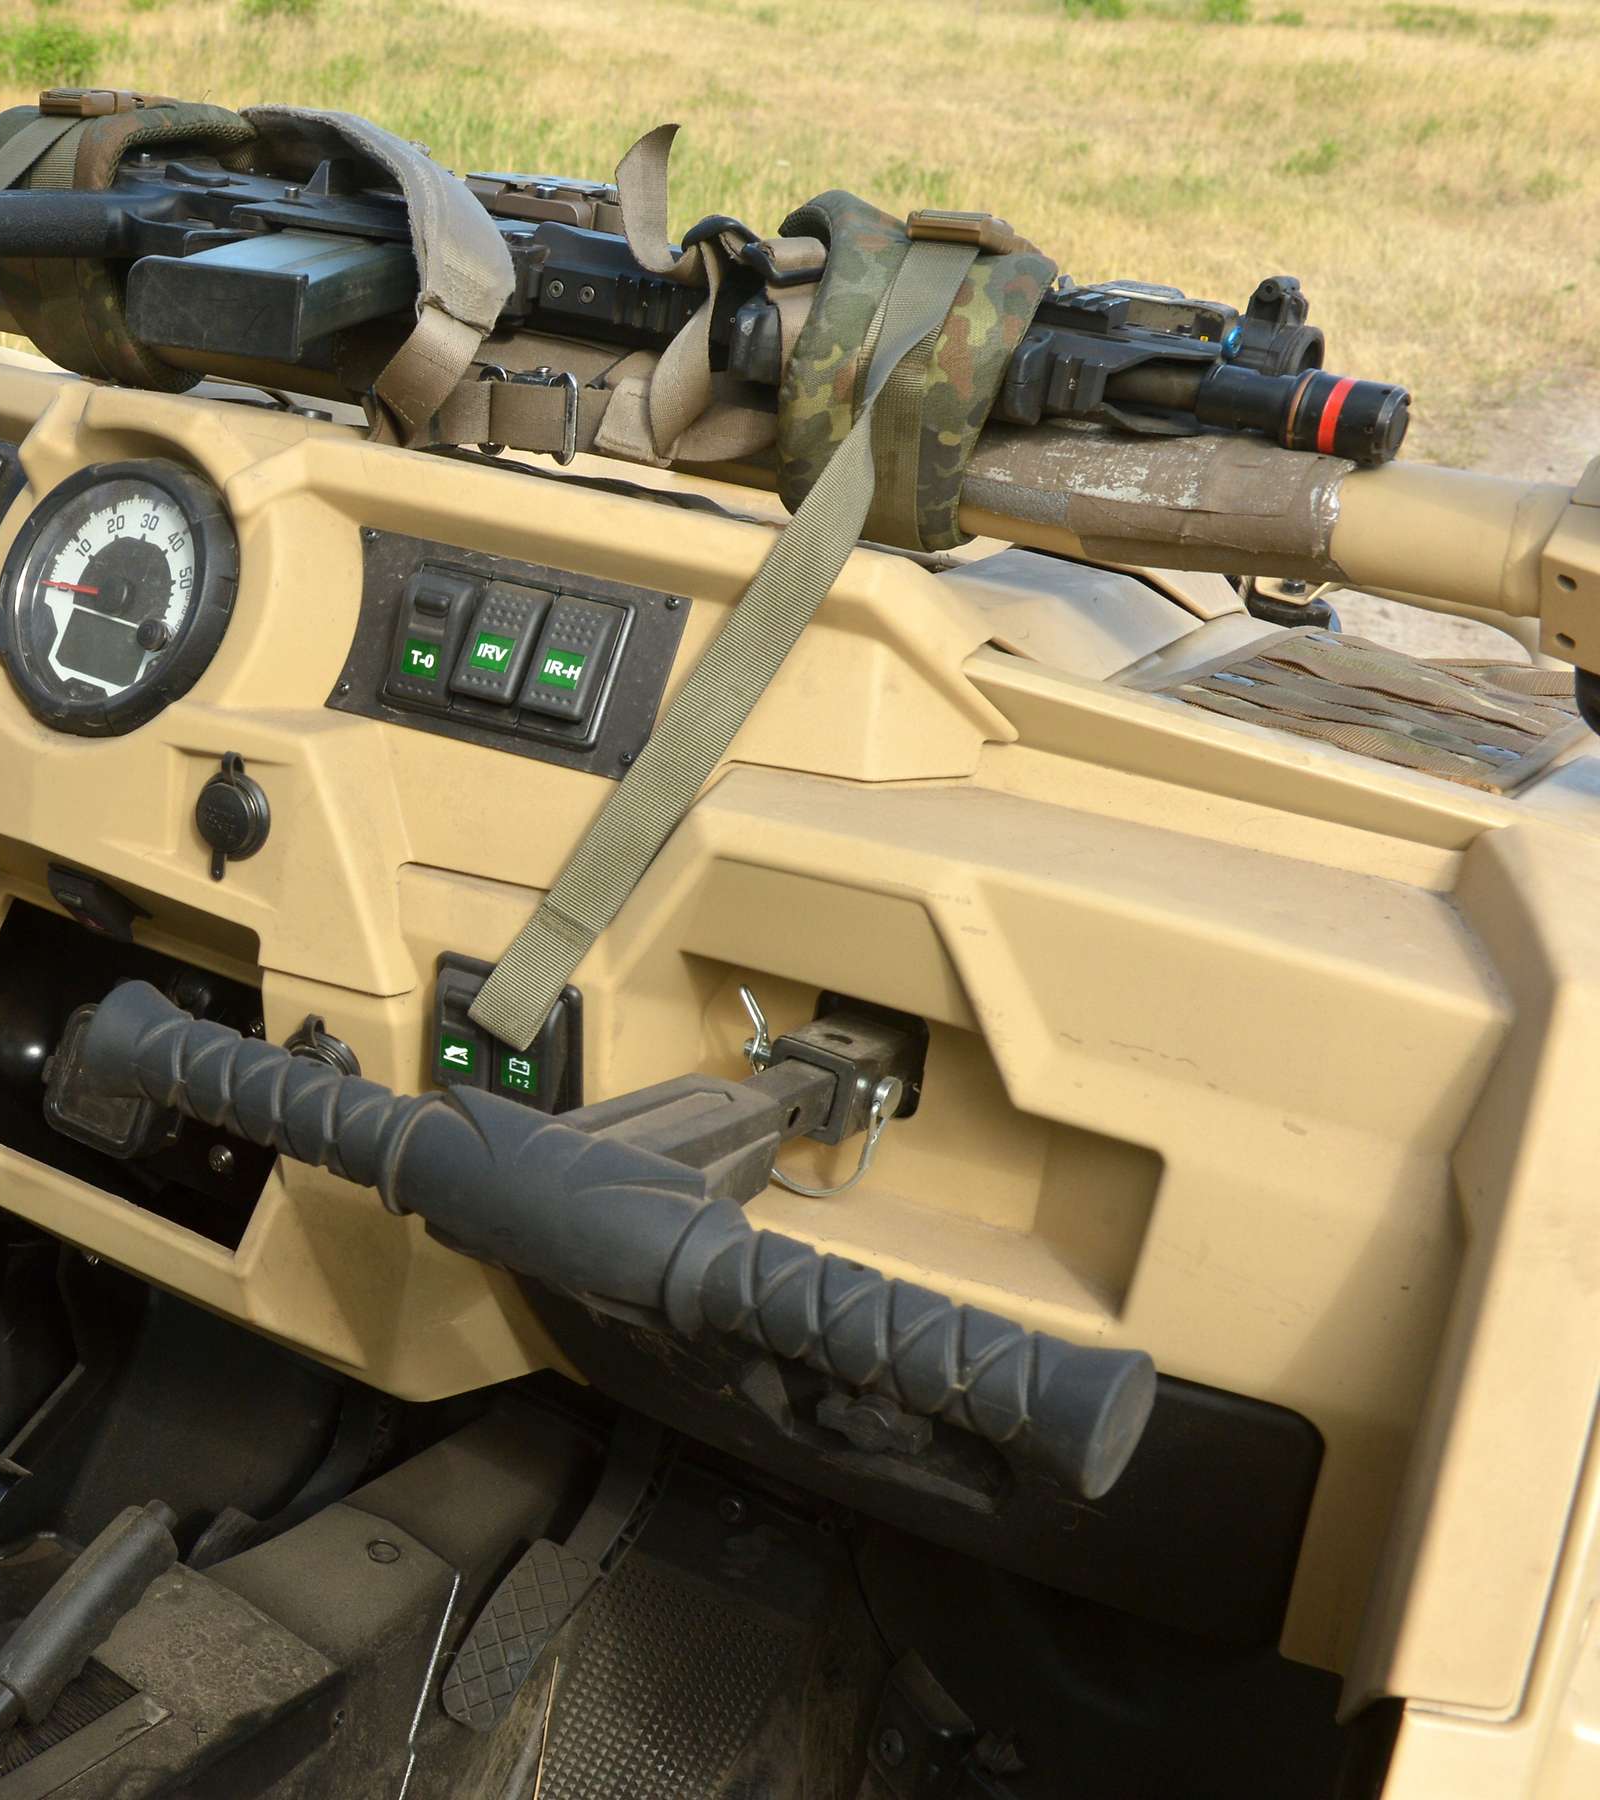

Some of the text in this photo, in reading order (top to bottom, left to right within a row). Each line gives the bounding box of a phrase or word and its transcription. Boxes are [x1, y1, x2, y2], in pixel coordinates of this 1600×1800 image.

[75, 538, 92, 557] 10
[106, 515, 125, 534] 20
[140, 513, 160, 531] 30
[167, 531, 185, 553] 40
[179, 566, 193, 590] 50
[476, 642, 508, 662] IRV
[543, 658, 582, 681] IR-H
